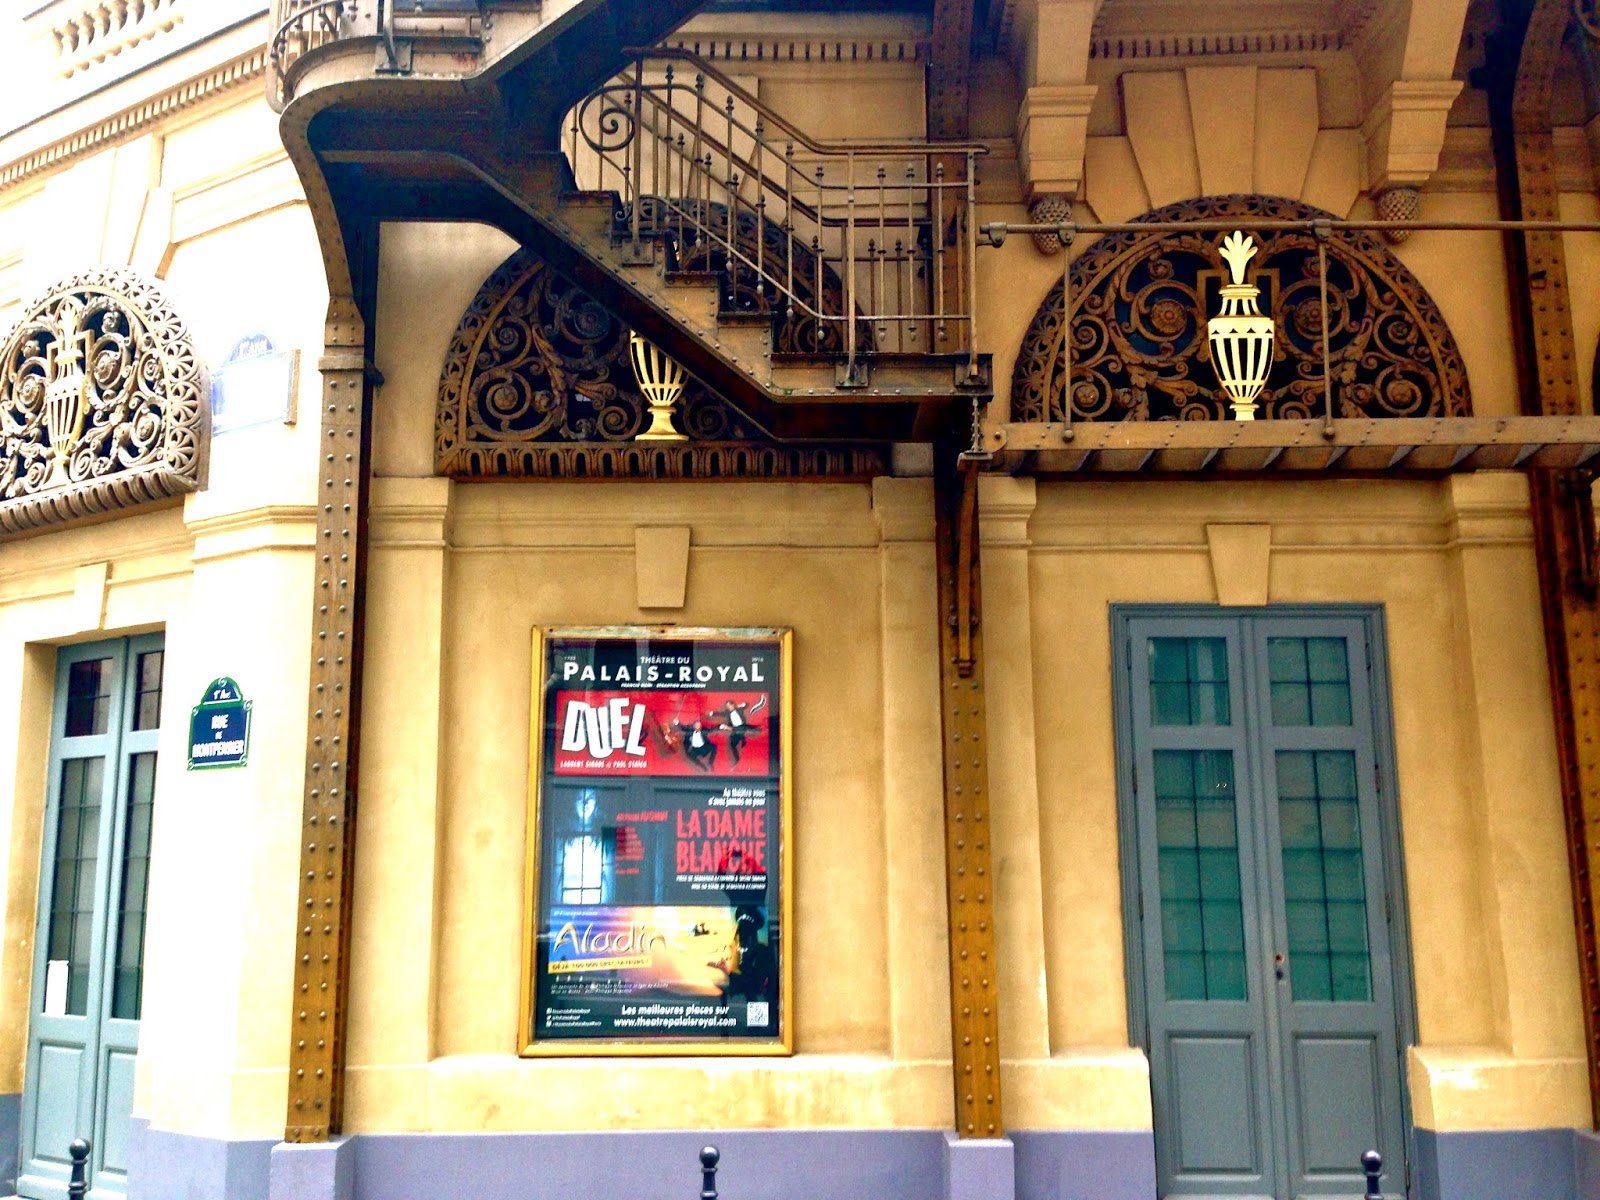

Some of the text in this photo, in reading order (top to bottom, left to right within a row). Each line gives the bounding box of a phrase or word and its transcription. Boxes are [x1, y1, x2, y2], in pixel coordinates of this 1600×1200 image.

[640, 654, 690, 664] THÉÂTRE DU
[563, 661, 765, 682] PALAIS-ROYAL
[211, 714, 229, 729] RUE
[561, 697, 646, 759] DUEL
[215, 731, 223, 740] DE
[677, 808, 766, 839] LA DAME
[676, 838, 766, 875] BLANCHE
[553, 920, 667, 956] Aladin
[622, 1004, 730, 1016] Les meilleures places sur
